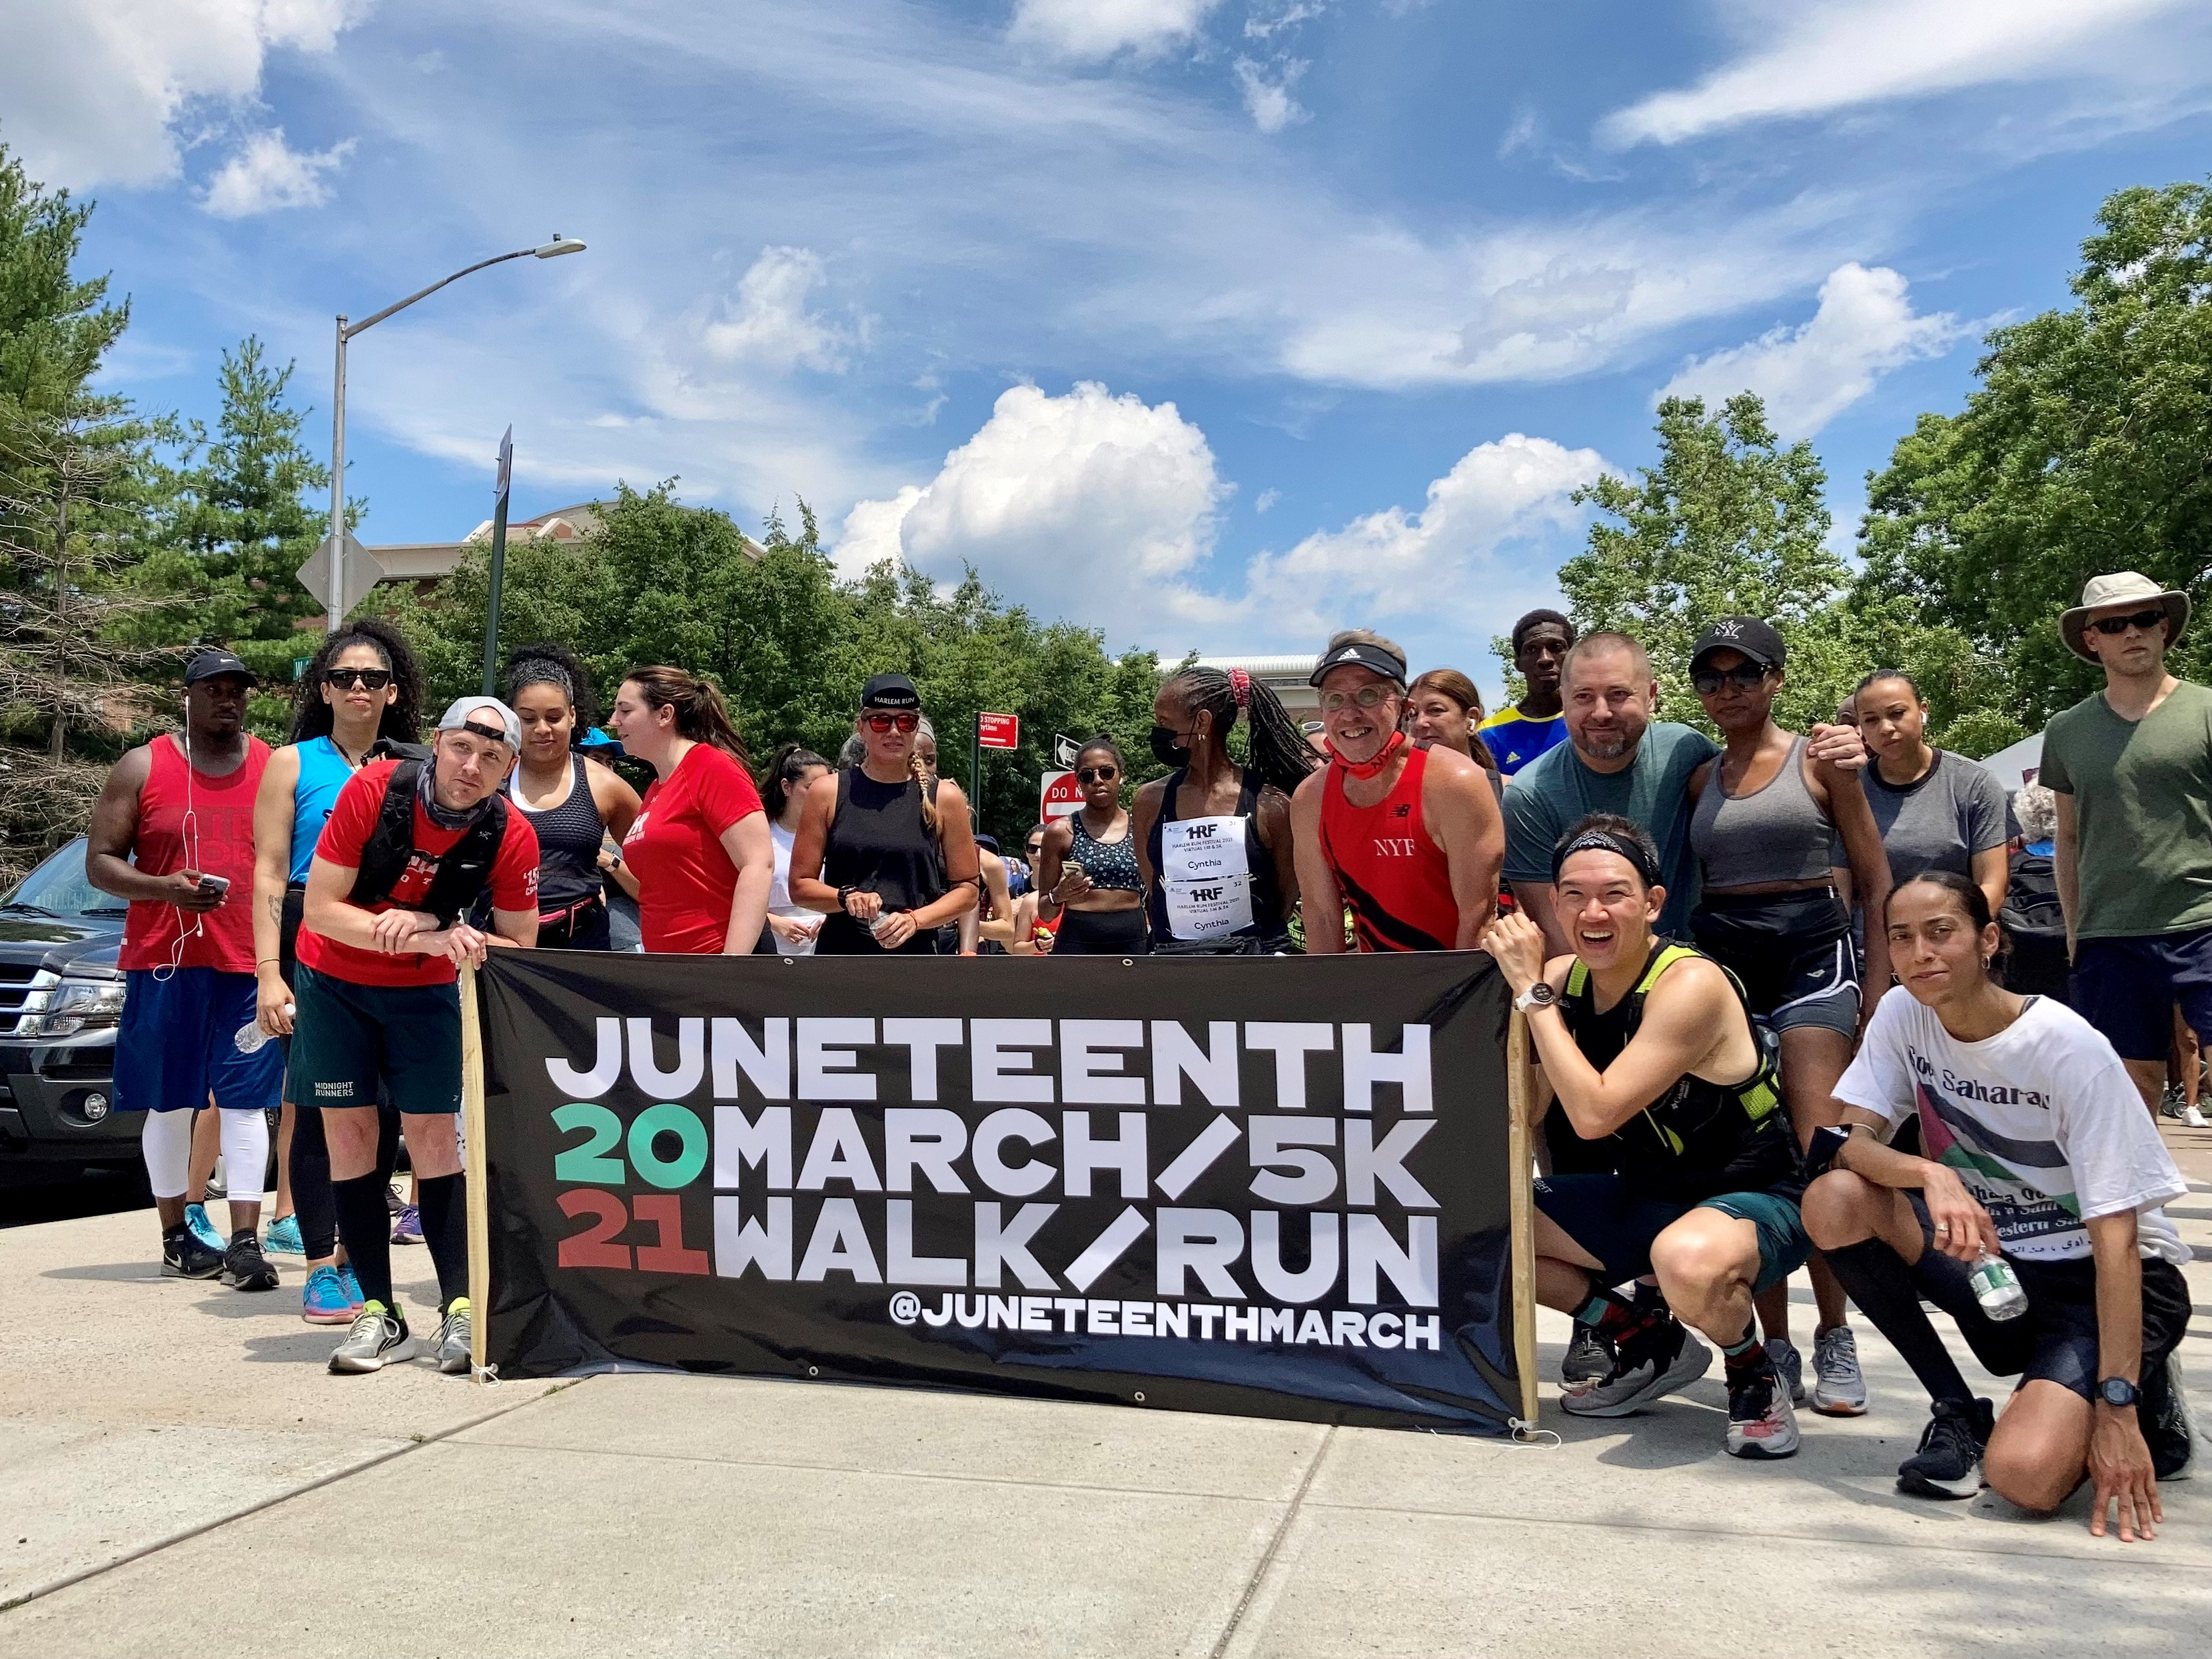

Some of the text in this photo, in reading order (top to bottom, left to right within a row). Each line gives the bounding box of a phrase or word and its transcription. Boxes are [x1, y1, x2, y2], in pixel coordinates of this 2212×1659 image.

[874, 696, 900, 705] HARLEM
[984, 716, 1010, 725] STOPPING
[1051, 787, 1067, 799] DO
[1188, 859, 1222, 870] Cynthia
[1194, 919, 1229, 931] Cynthia
[546, 1017, 1432, 1111] JUNETEENTH
[314, 1081, 354, 1090] MIDNIGHT
[551, 1103, 708, 1188] 20
[558, 1189, 709, 1275] 21
[1993, 1220, 2049, 1238] estern
[889, 1291, 1439, 1351] @JUNETEENTHMARCH
